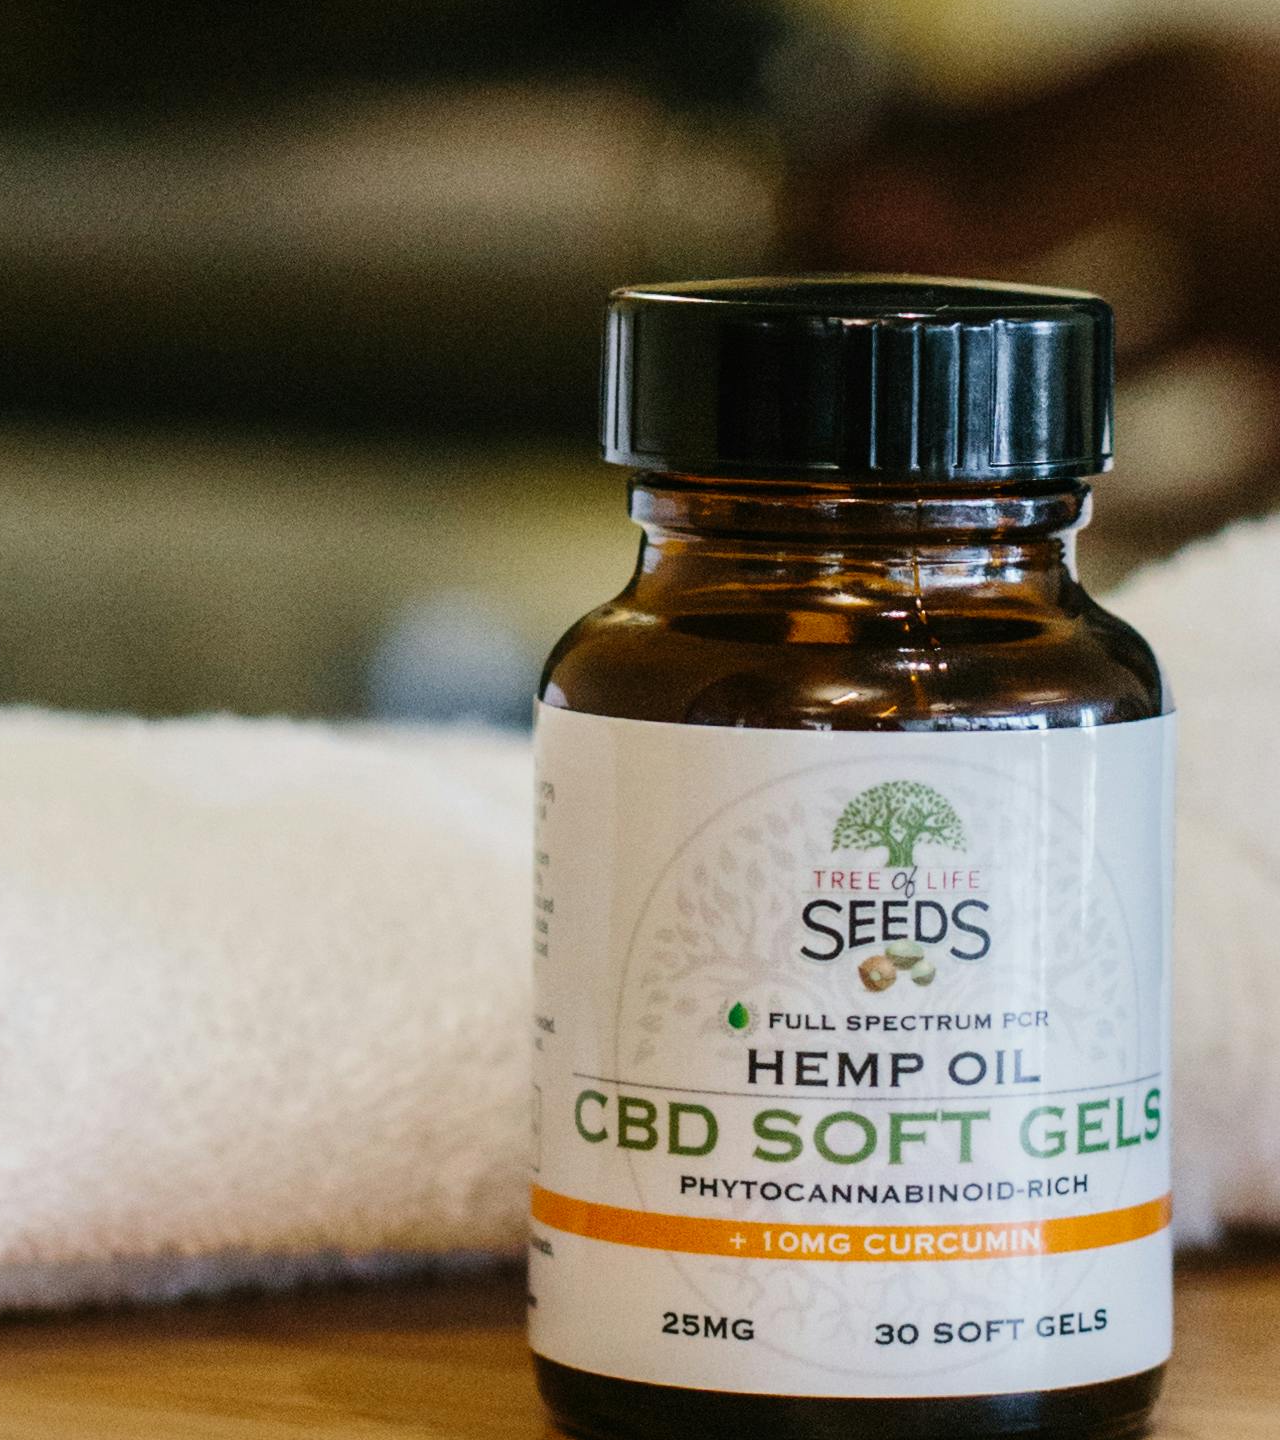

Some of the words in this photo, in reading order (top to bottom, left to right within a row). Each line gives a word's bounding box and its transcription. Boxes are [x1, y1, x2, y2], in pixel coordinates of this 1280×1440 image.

[812, 870, 881, 890] TREE
[927, 870, 981, 890] LIFE
[800, 898, 992, 961] SEEDS
[768, 1012, 836, 1031] FULL
[846, 1013, 992, 1032] SPECTRUM
[747, 1048, 925, 1088] HEMP
[947, 1049, 1041, 1086] OIL
[574, 1089, 719, 1158] CBD
[751, 1108, 991, 1166] SOFT
[1019, 1088, 1162, 1160] GELS
[679, 1173, 1089, 1205] PHYTOCANNABINOID-RICH
[728, 1232, 747, 1250] +
[763, 1230, 851, 1256] 10MG
[863, 1227, 1042, 1255] CURCUMIN
[661, 1311, 755, 1342] 25MG
[874, 1323, 920, 1346] 30
[933, 1317, 1025, 1345] SOFT
[1035, 1308, 1108, 1337] GELS
